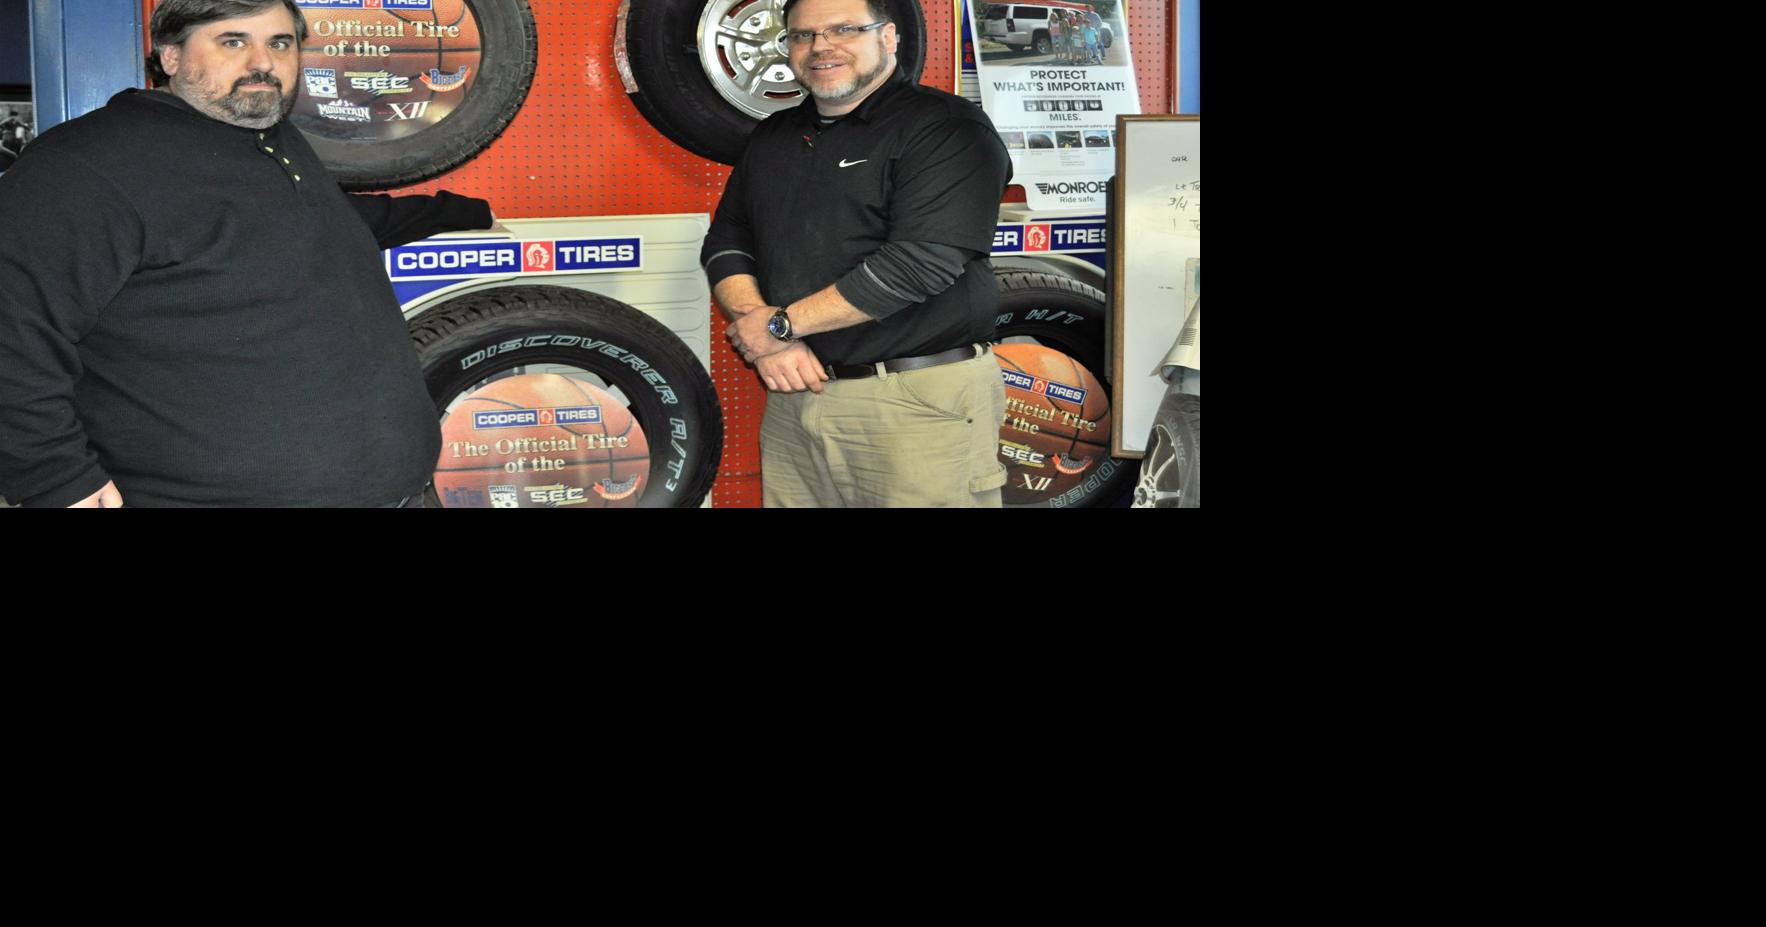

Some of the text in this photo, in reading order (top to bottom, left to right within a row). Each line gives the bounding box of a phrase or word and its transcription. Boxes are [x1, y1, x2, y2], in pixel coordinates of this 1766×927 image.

[313, 20, 460, 38] Official Tire
[323, 40, 391, 57] of the
[351, 77, 409, 89] SEC
[1030, 70, 1087, 80] PROTECT
[993, 82, 1126, 92] WHAT'S IMPORTANT!
[316, 103, 371, 120] MOUNTAIN
[1049, 113, 1082, 121] MILES.
[1047, 181, 1107, 194] MONROE
[397, 244, 635, 270] COOPER TIRES
[1025, 309, 1085, 325] H/T
[460, 334, 678, 405] DISCOVERER
[1048, 384, 1083, 401] TIRES
[477, 409, 598, 425] COOPER TIRES
[1013, 416, 1040, 435] the
[1060, 410, 1098, 432] Tire
[448, 433, 628, 458] The Official Tire
[1001, 444, 1045, 464] SEC
[504, 455, 566, 474] of the
[530, 488, 584, 503] SEC
